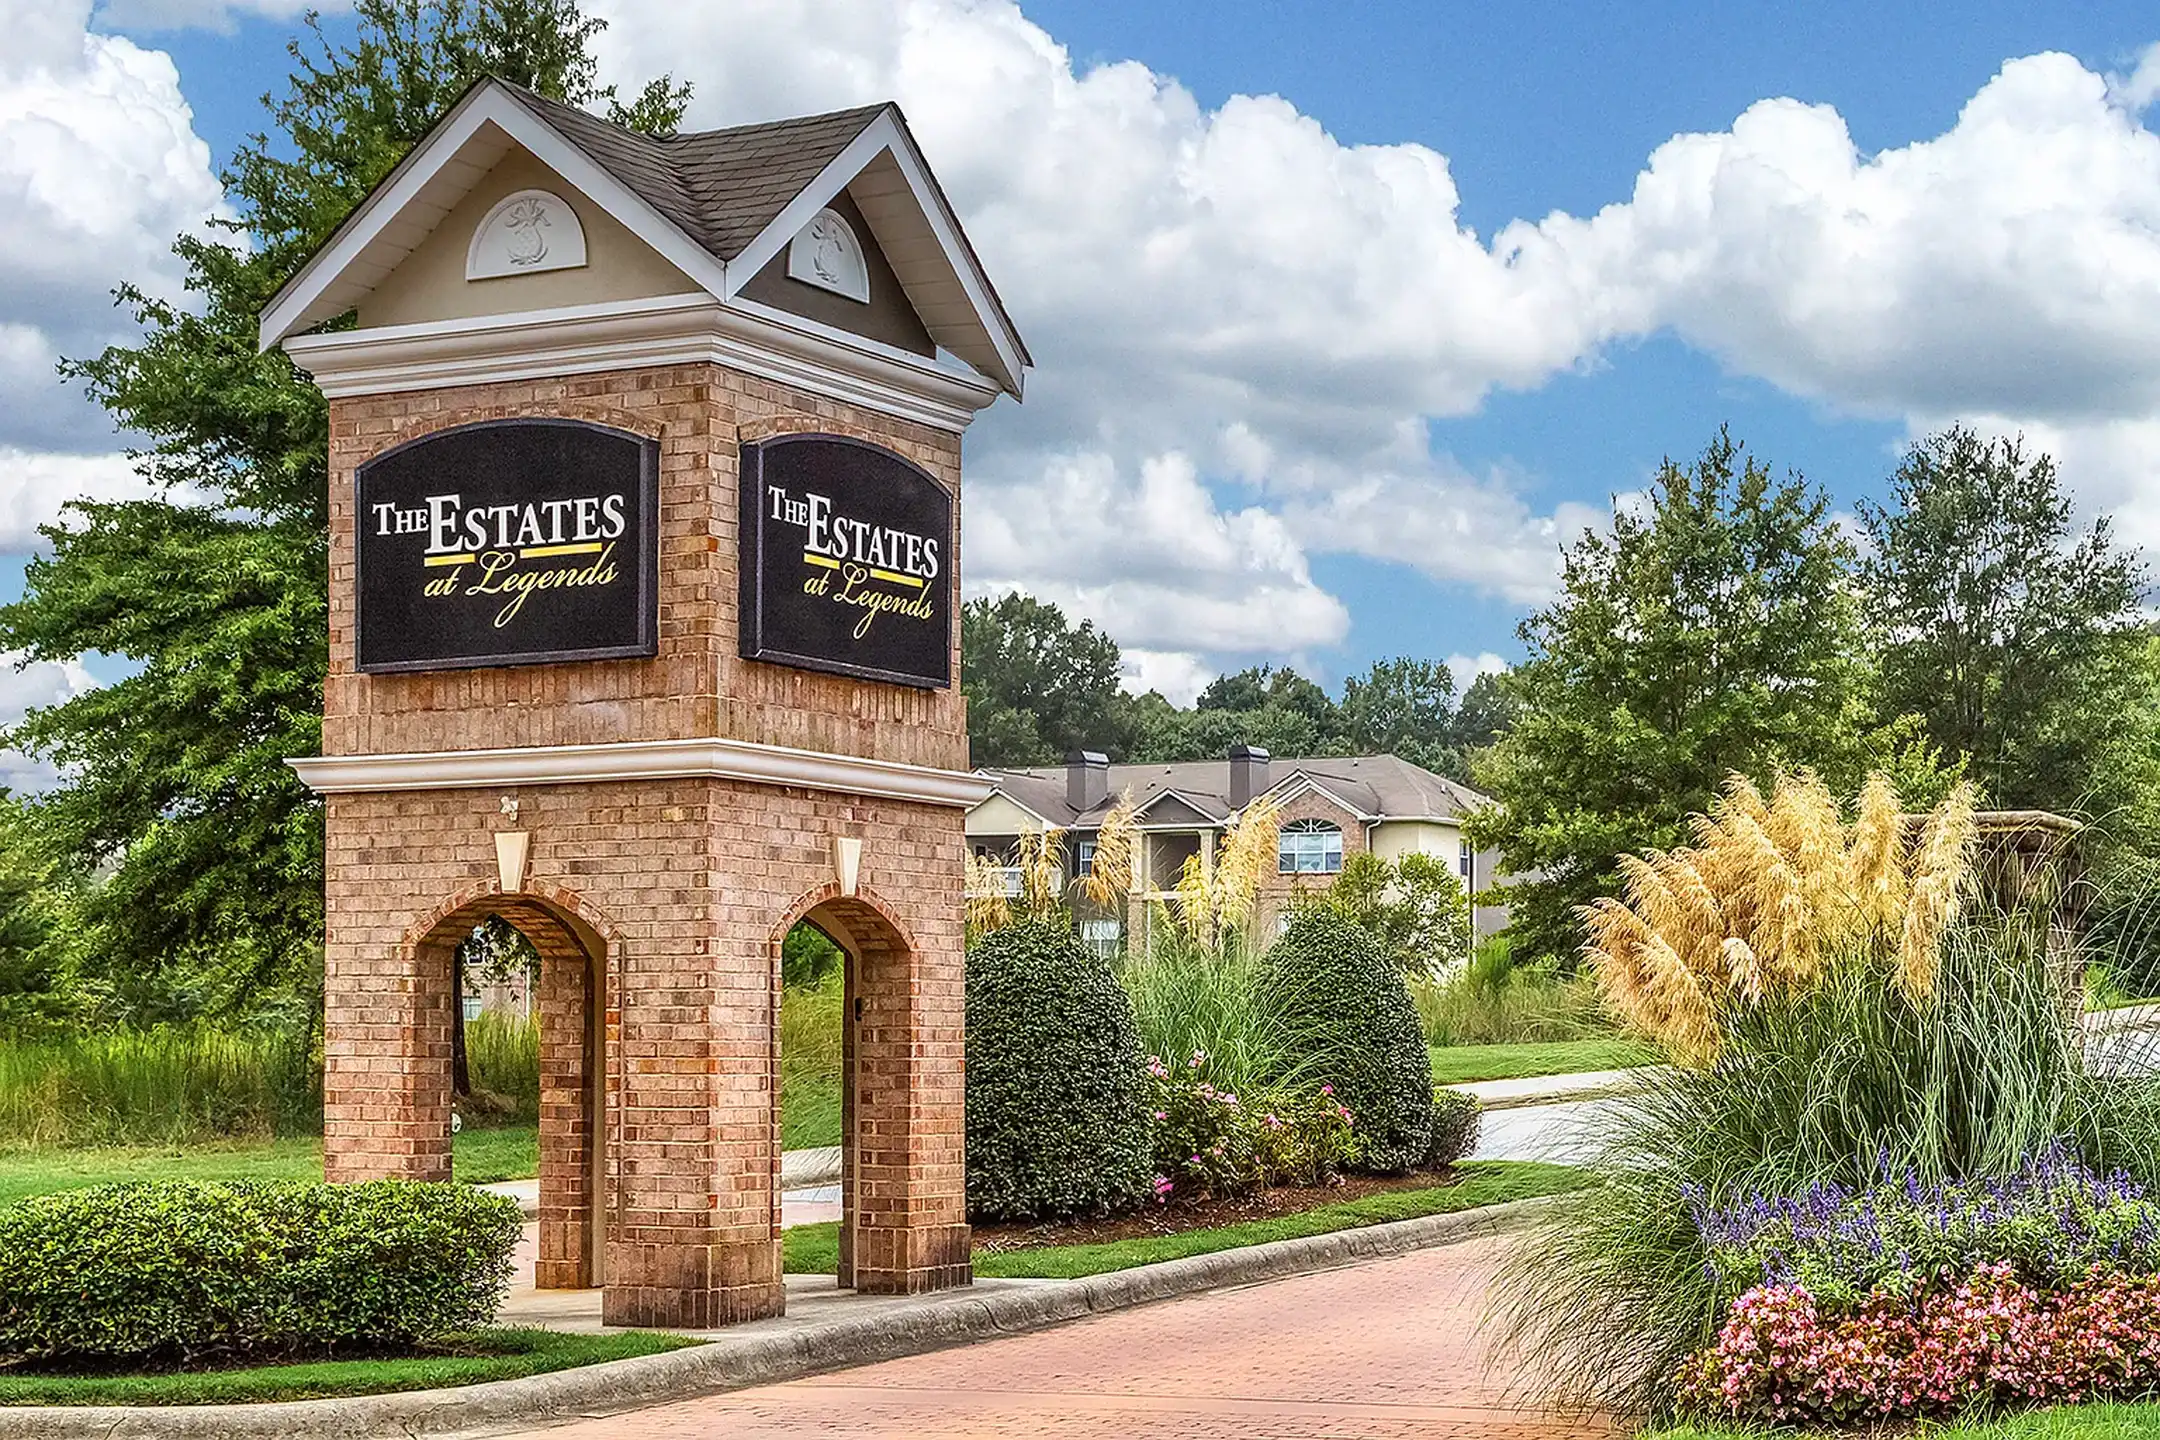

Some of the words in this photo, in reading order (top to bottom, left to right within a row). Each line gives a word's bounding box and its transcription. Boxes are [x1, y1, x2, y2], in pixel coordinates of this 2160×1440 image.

[424, 494, 626, 554] ESTATES
[804, 493, 939, 579] ESTATES
[423, 566, 462, 597] at
[466, 541, 618, 628] Legends
[803, 569, 831, 596] at
[833, 562, 934, 639] Legends
